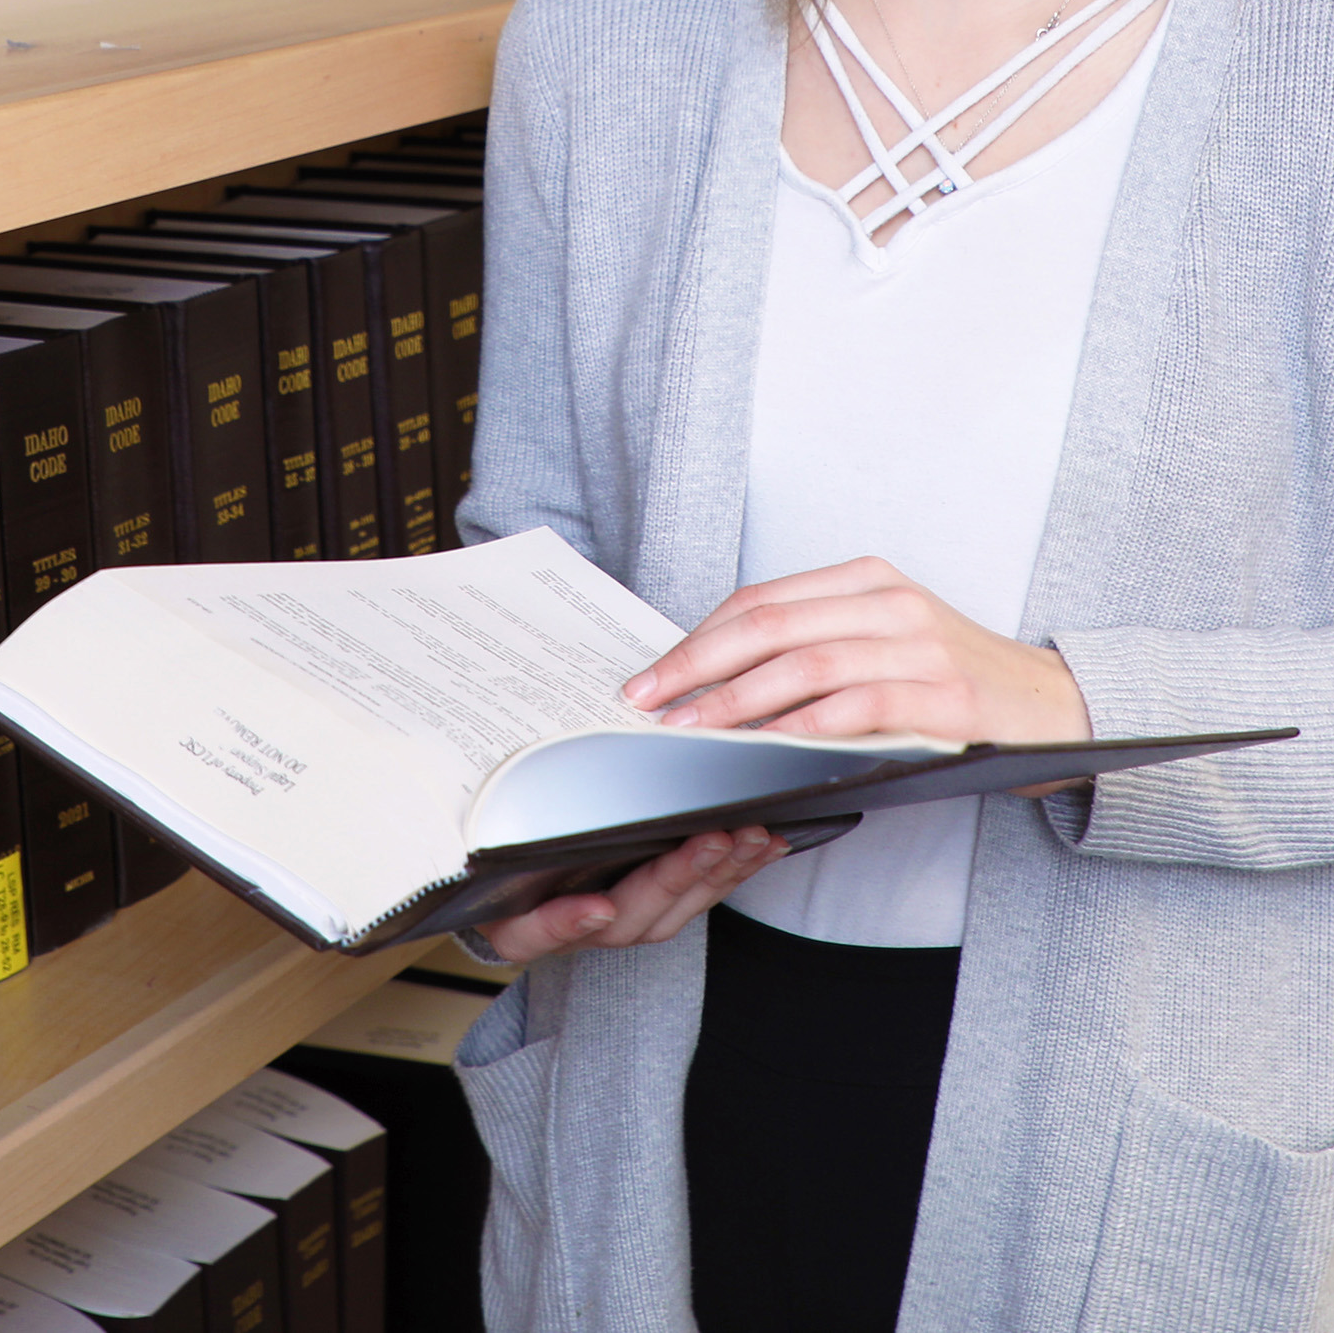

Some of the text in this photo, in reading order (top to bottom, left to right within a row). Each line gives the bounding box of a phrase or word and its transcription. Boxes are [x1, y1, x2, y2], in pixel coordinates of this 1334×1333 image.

[390, 310, 426, 338] IDAHO
[394, 333, 425, 360] CODE
[278, 368, 312, 396] CODE
[337, 355, 368, 383] CODE
[208, 373, 243, 404] IDAHO
[104, 396, 143, 429] IDAHO
[211, 399, 241, 428] CODE
[24, 424, 68, 457] IDAHO
[109, 423, 142, 454] CODE
[29, 452, 68, 483] CODE
[213, 485, 248, 509] TITLES
[113, 512, 152, 538] TITLES
[32, 547, 78, 574] TITLES
[257, 743, 286, 765] NOT
[283, 758, 308, 775] DO
[221, 765, 265, 796] Property
[262, 771, 297, 793] Legal
